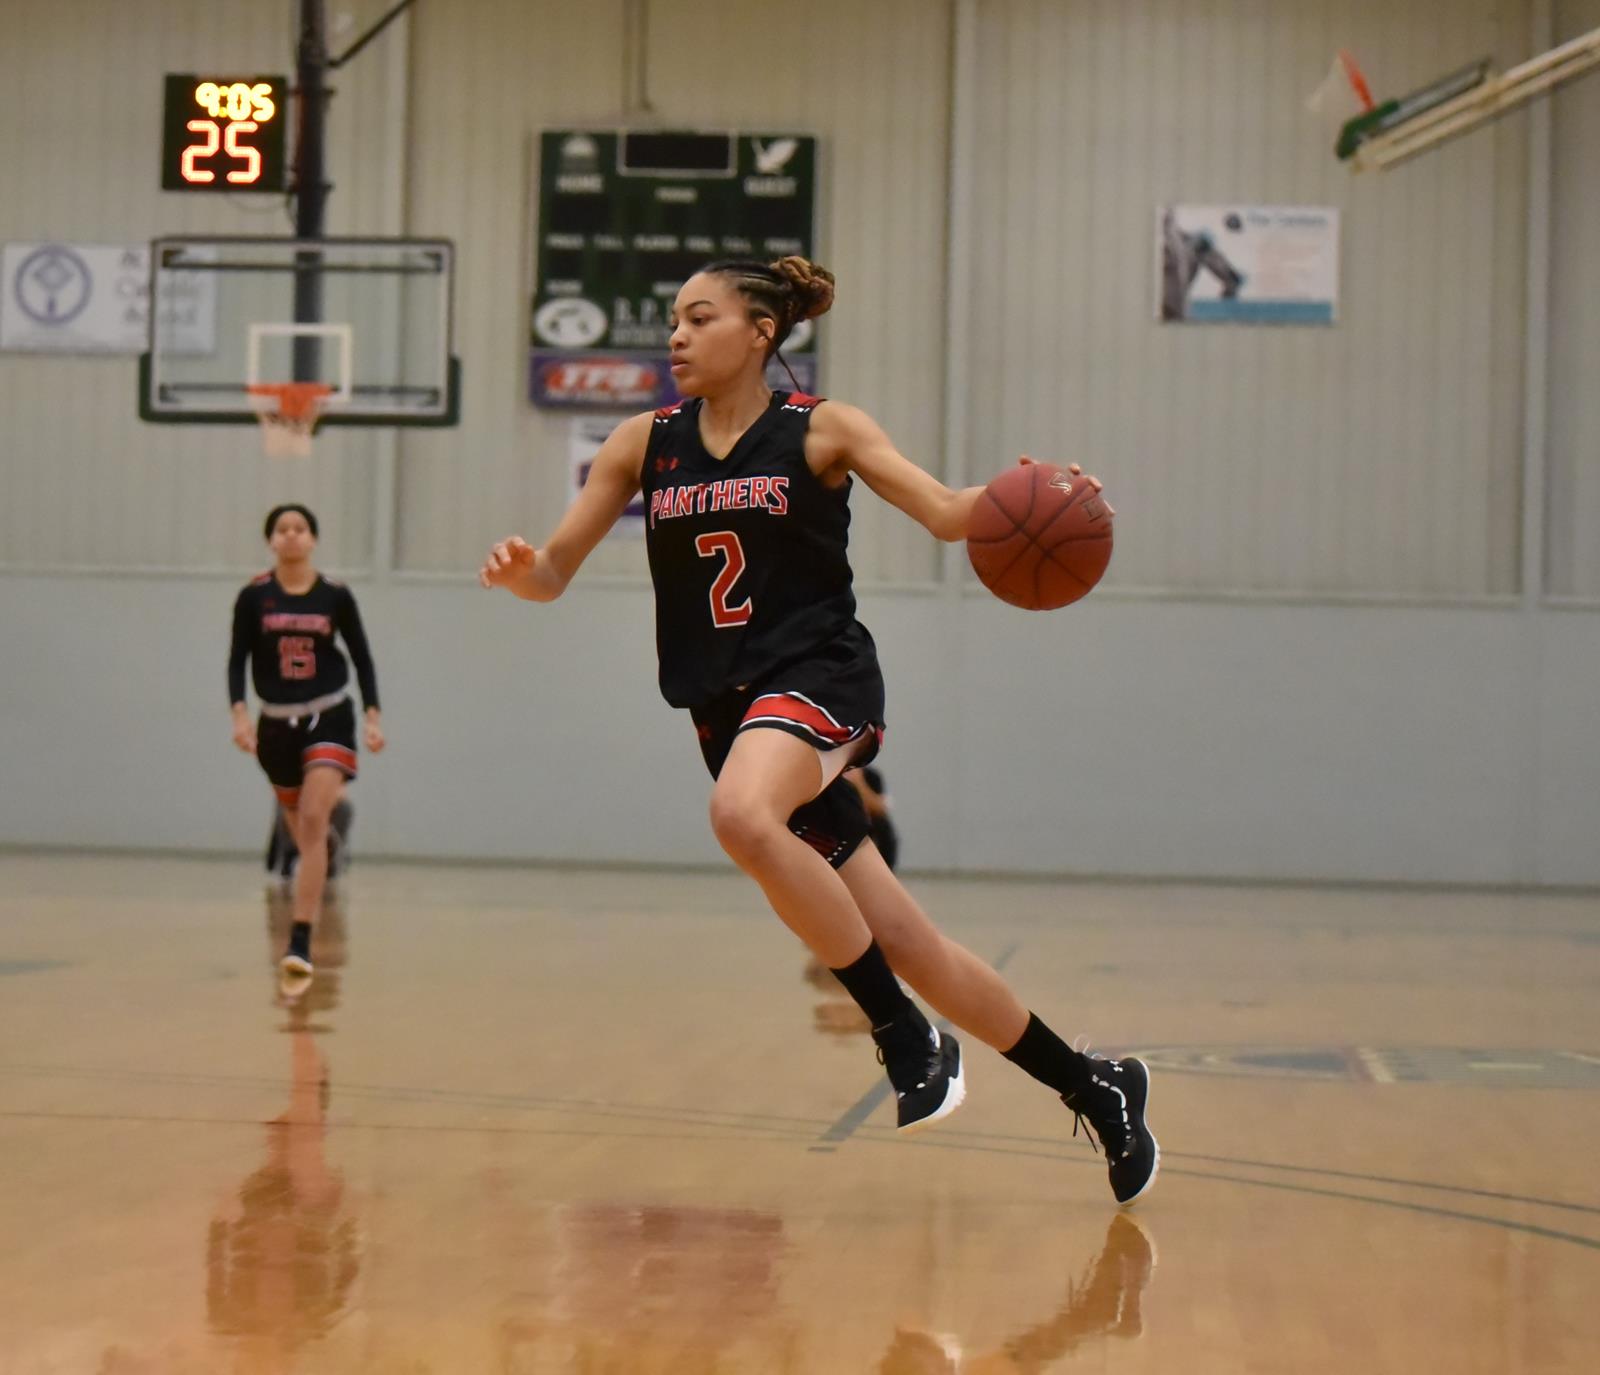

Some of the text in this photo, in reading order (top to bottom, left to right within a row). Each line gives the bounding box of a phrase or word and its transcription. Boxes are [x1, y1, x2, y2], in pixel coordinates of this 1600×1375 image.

[195, 82, 275, 122] 9:05
[181, 120, 261, 183] 25
[651, 476, 790, 530] PANTHERS
[695, 531, 753, 628] 2
